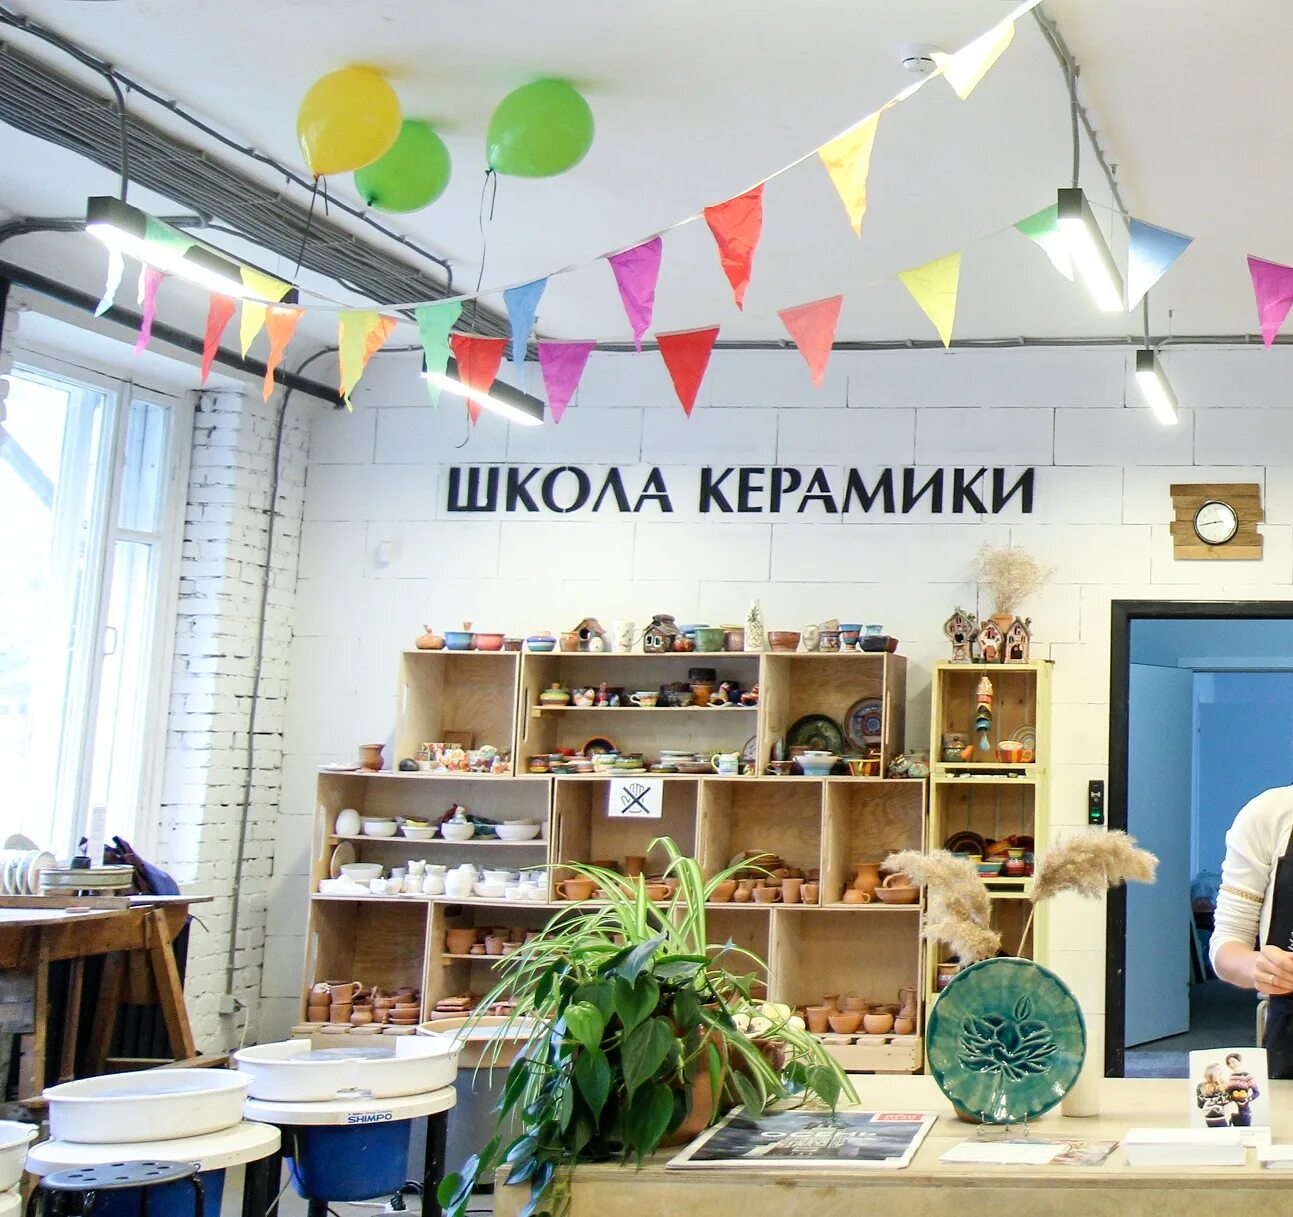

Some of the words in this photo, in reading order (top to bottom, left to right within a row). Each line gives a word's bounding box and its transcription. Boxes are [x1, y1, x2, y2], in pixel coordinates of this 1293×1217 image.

[446, 466, 673, 514] ШКОЛА
[699, 466, 1035, 515] КЕРАМИКИ
[347, 1113, 393, 1123] SHIMPO
